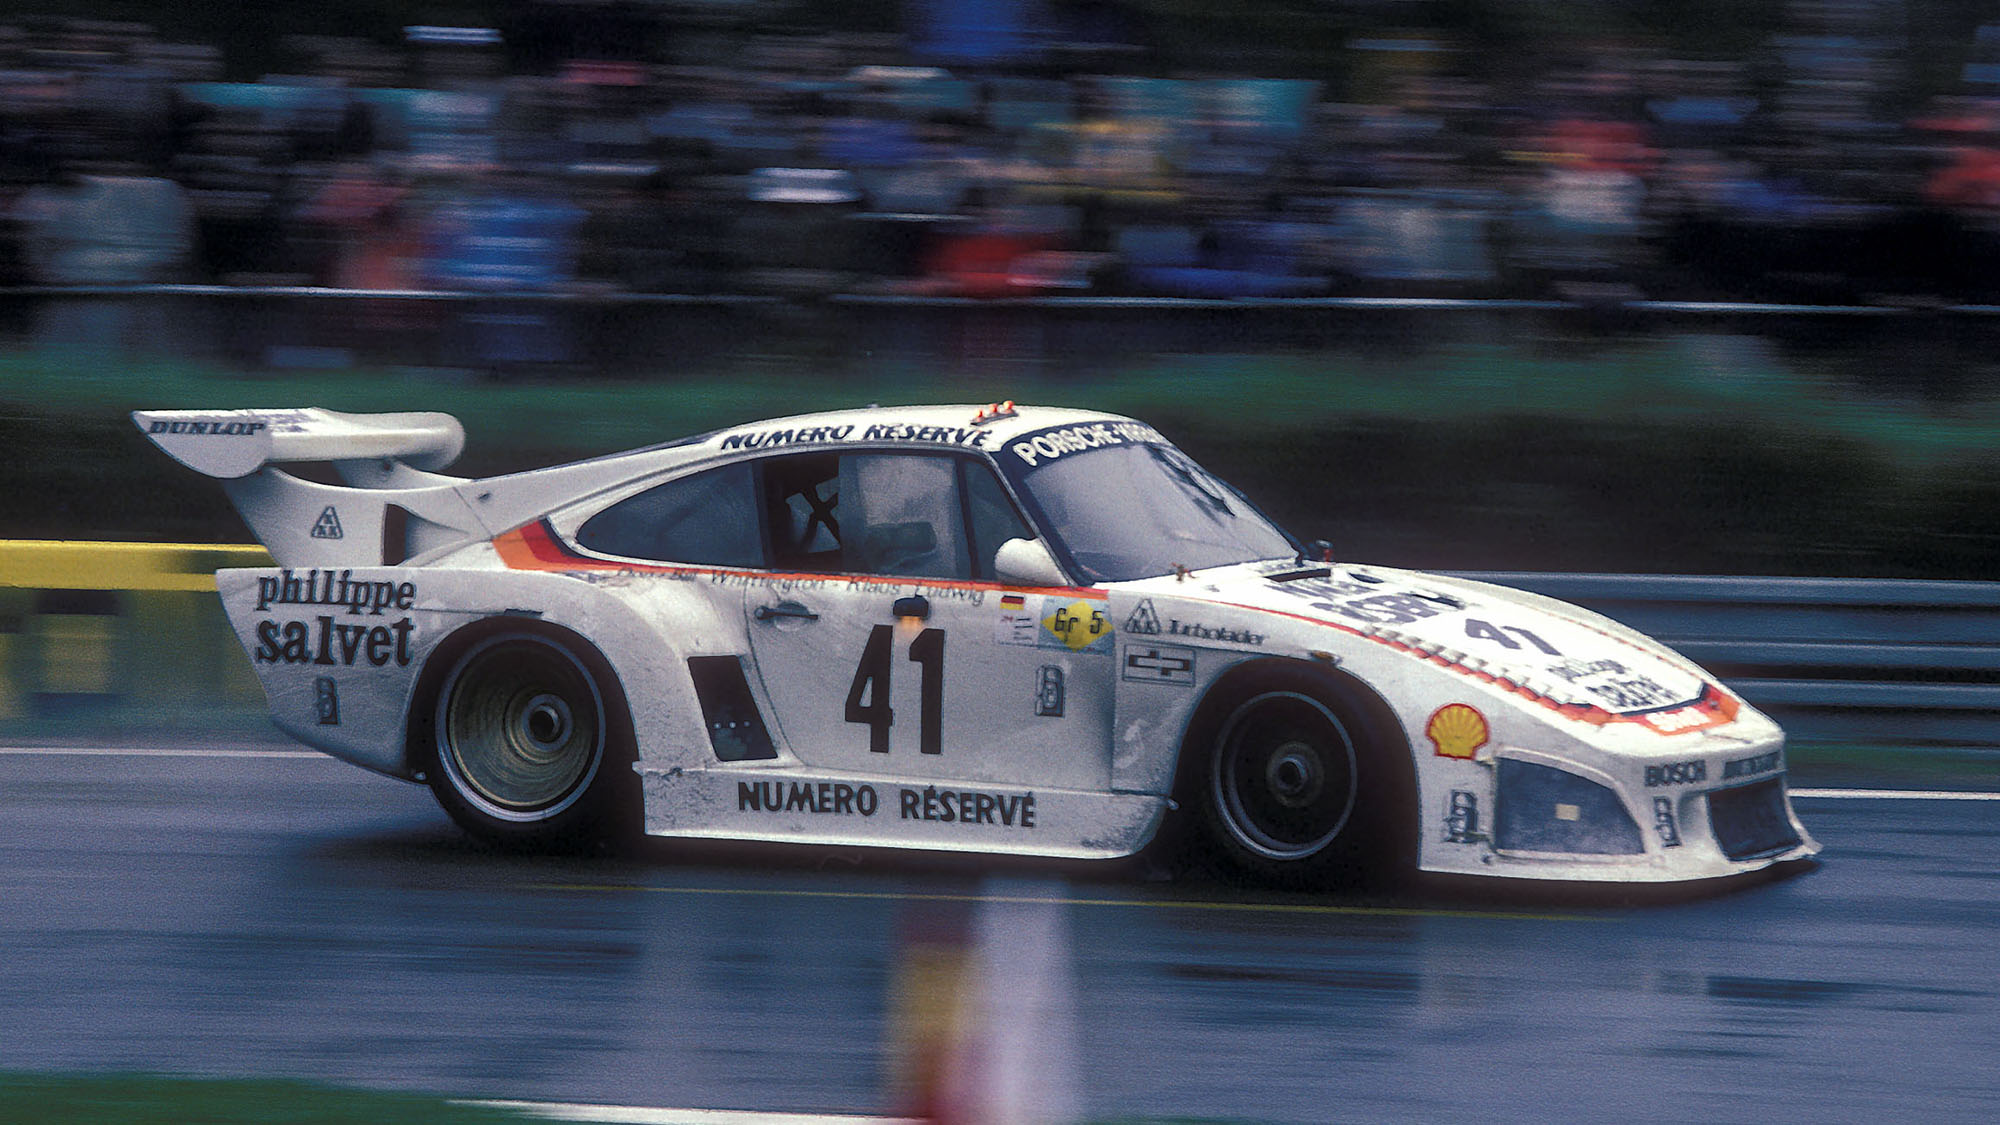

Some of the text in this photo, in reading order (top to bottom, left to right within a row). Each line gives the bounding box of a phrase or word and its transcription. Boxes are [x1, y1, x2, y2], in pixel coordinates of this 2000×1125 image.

[149, 420, 266, 436] DUNLOP
[720, 425, 855, 449] NUMERO
[255, 569, 415, 615] philippe
[257, 615, 414, 667] salvet
[1089, 610, 1104, 634] 5
[1465, 618, 1563, 656] 41
[845, 624, 945, 755] 41
[1644, 760, 1706, 787] BOSCH
[738, 782, 1035, 827] NUMERO RÉSERVÉ
